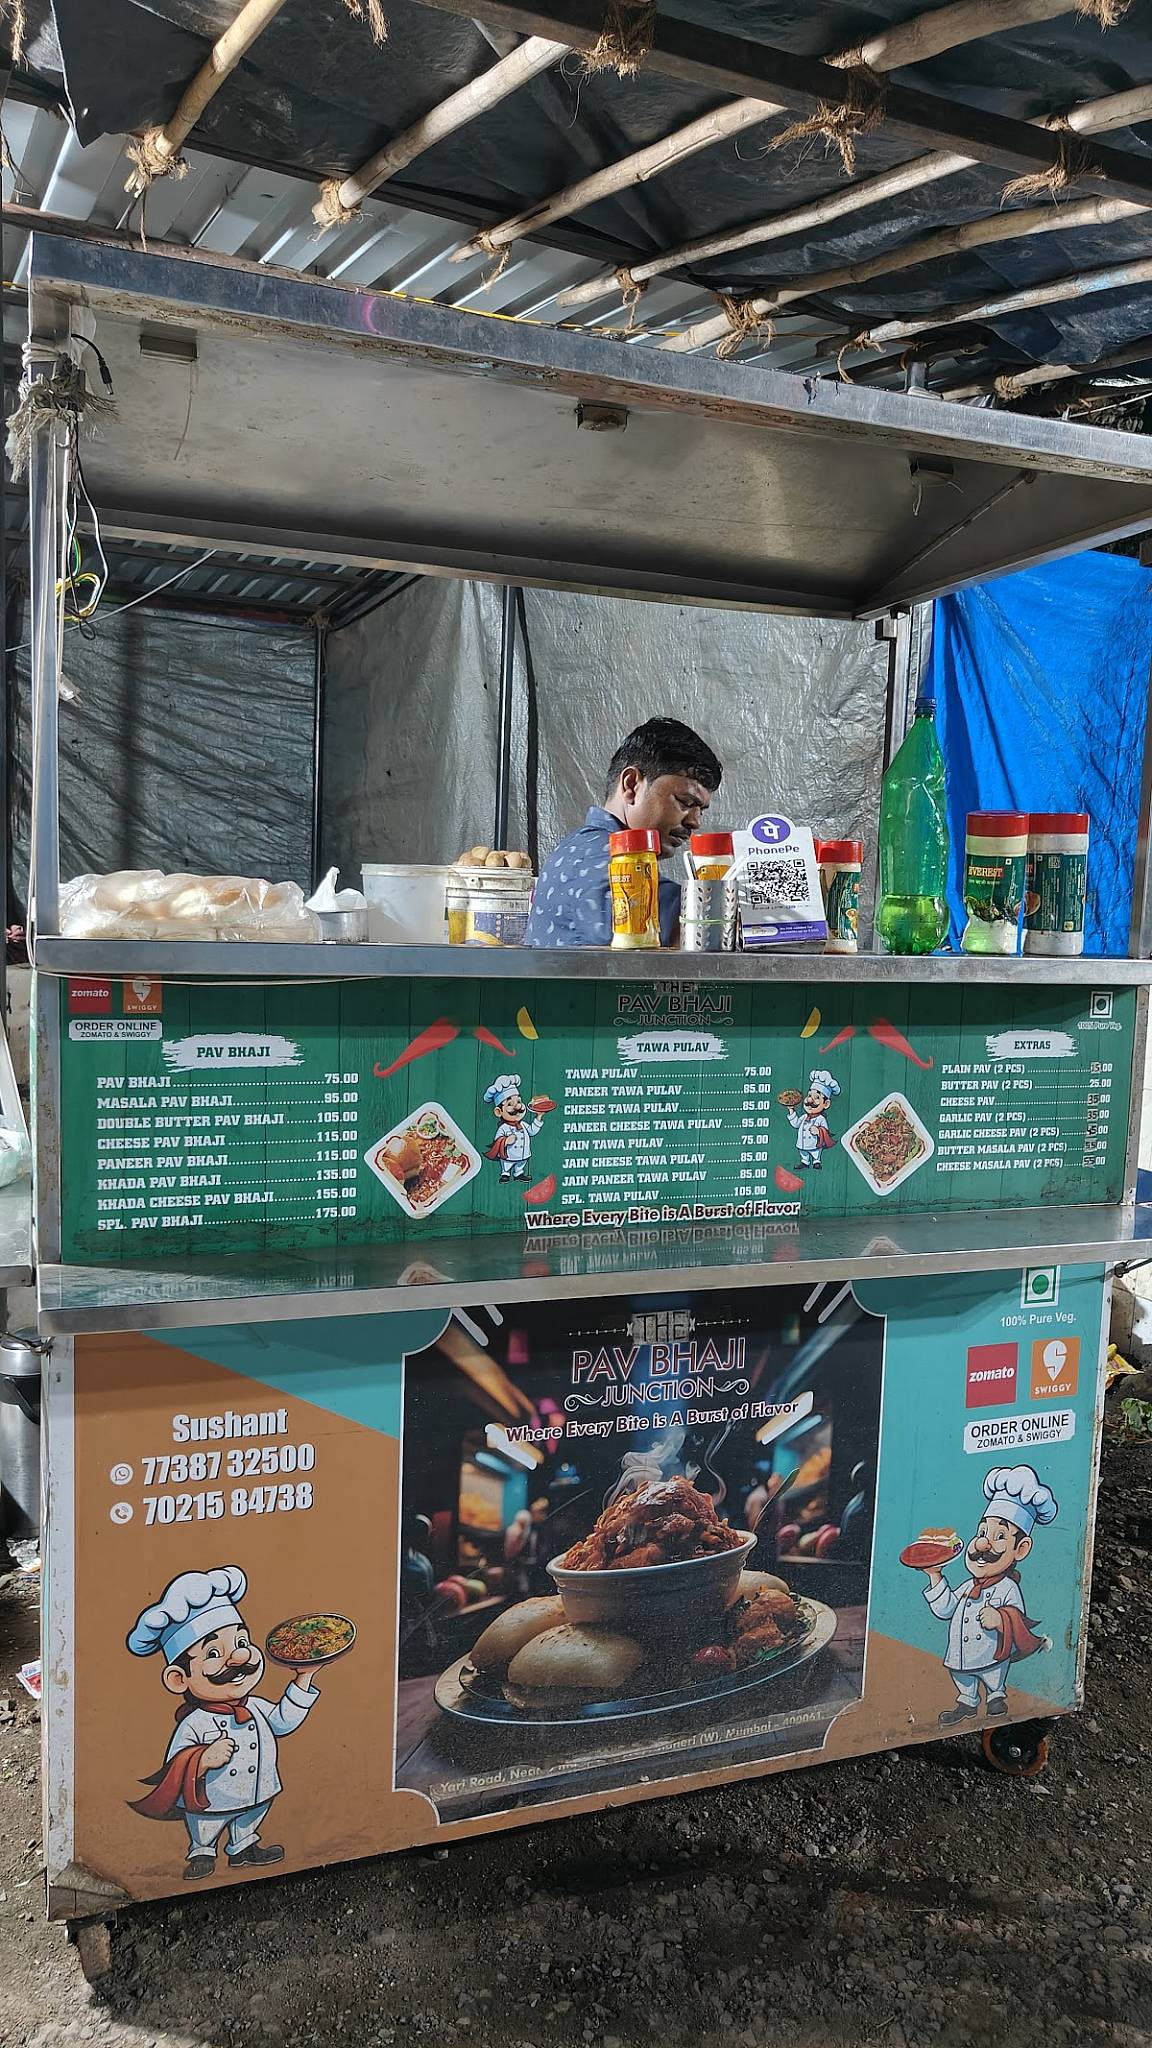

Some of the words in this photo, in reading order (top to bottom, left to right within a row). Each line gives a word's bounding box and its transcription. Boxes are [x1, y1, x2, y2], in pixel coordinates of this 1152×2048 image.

[748, 845, 799, 855] PhonePe
[969, 866, 1003, 877] EVEREST
[661, 981, 692, 993] THE
[618, 995, 662, 1013] PAV
[669, 995, 732, 1013] BHAJI
[75, 1022, 113, 1030] ORDER
[117, 1022, 156, 1030] ONLINE
[637, 1015, 712, 1025] JUNCTION
[197, 1046, 223, 1058] PAV
[228, 1046, 271, 1058] BHAJI
[637, 1043, 670, 1052] TAWA
[674, 1042, 709, 1052] PULAV
[1014, 1040, 1051, 1049] EXTRAS
[566, 1069, 599, 1079] TAWA
[602, 1068, 638, 1079] PULAV
[744, 1067, 771, 1077] 75.00
[942, 1065, 971, 1074] PLAIN
[974, 1064, 991, 1073] PAV
[994, 1064, 1004, 1074] (2
[1006, 1064, 1025, 1074] PCS)
[97, 1077, 124, 1089] PAV
[128, 1077, 171, 1088] BHAJI
[325, 1073, 358, 1084] 75.00
[941, 1080, 977, 1090] BUTTER
[981, 1080, 998, 1089] PAV
[1001, 1080, 1011, 1090] (2
[1014, 1080, 1032, 1090] PCS)
[1089, 1079, 1111, 1088] 25.00
[564, 1087, 608, 1097] PANEER
[611, 1086, 644, 1096] TAWA
[647, 1085, 682, 1095] PULAV
[743, 1084, 770, 1094] 85.00
[97, 1097, 157, 1108] MASALA
[161, 1096, 188, 1108] PAV
[191, 1096, 232, 1107] BHAJI
[324, 1093, 358, 1103] 95.00
[564, 1104, 605, 1115] CHEESE
[608, 1103, 640, 1114] TAWA
[644, 1102, 679, 1113] PULAV
[742, 1101, 769, 1111] 85.00
[940, 1097, 974, 1106] CHEESE
[977, 1096, 995, 1106] PAV
[97, 1118, 151, 1129] DOUBLE
[155, 1115, 211, 1127] BUTTER
[215, 1115, 240, 1127] PAV
[244, 1114, 284, 1125] BHAJI
[317, 1111, 358, 1123] 105.00
[939, 1113, 970, 1122] GARLIC
[973, 1112, 992, 1122] PAV
[995, 1112, 1005, 1122] (2
[1007, 1112, 1026, 1122] PCS)
[563, 1122, 607, 1133] PANEER
[610, 1121, 650, 1132] CHEESE
[653, 1120, 685, 1131] TAWA
[688, 1119, 722, 1129] PULAV
[741, 1118, 769, 1128] 95.00
[939, 1129, 968, 1139] GARLIC
[971, 1128, 1007, 1138] CHEESE
[1009, 1128, 1027, 1137] PAV
[1029, 1127, 1039, 1138] (2
[1041, 1127, 1059, 1137] PCS)
[98, 1138, 150, 1150] CHEESE
[153, 1137, 180, 1149] PAV
[184, 1136, 225, 1147] BHAJI
[317, 1131, 357, 1142] 115.00
[563, 1140, 590, 1151] JAIN
[593, 1139, 625, 1149] TAWA
[627, 1138, 663, 1148] PULAV
[741, 1135, 768, 1146] 75.00
[98, 1158, 153, 1170] PANEER
[156, 1157, 183, 1168] PAV
[187, 1155, 228, 1167] BHAJI
[316, 1150, 357, 1161] 115.00
[563, 1158, 589, 1169] JAIN
[592, 1156, 632, 1167] CHEESE
[635, 1156, 667, 1166] TAWA
[670, 1154, 705, 1165] PULAV
[740, 1152, 768, 1163] 85.00
[98, 1178, 146, 1190] KHADA
[150, 1177, 176, 1189] PAV
[180, 1175, 221, 1187] BHAJI
[316, 1169, 357, 1180] 135.00
[562, 1176, 589, 1187] JAIN
[591, 1174, 634, 1185] PANEER
[636, 1173, 669, 1184] TAWA
[671, 1171, 707, 1182] PULAV
[739, 1169, 767, 1180] 85.00
[98, 1199, 146, 1210] KHADA
[149, 1196, 201, 1208] CHEESE
[205, 1194, 230, 1206] PAV
[234, 1192, 274, 1203] BHAJI
[316, 1187, 356, 1199] 155.00
[562, 1193, 585, 1204] SPL.
[589, 1192, 621, 1203] TAWA
[624, 1190, 659, 1201] PULAV
[734, 1186, 766, 1197] 105.00
[98, 1218, 127, 1231] SPL.
[131, 1217, 158, 1229] PAV
[161, 1216, 203, 1227] BHAJI
[315, 1207, 356, 1218] 175.00
[527, 1214, 578, 1227] Where
[584, 1211, 625, 1226] Every
[629, 1207, 658, 1220] Bite
[663, 1207, 674, 1219] is
[677, 1206, 690, 1219] A
[695, 1205, 734, 1217] Burst
[736, 1203, 751, 1216] of
[755, 1201, 799, 1214] Flavor
[636, 1312, 687, 1343] THE
[1001, 1315, 1026, 1327] 100%
[1030, 1314, 1052, 1325] Pure
[1056, 1312, 1076, 1324] Veg.
[572, 1346, 640, 1384] PAV
[651, 1337, 746, 1377] BHAJI
[969, 1366, 1015, 1383] zomato
[1035, 1384, 1071, 1394] SWIGGY
[602, 1377, 714, 1407] JUNCTION
[173, 1409, 288, 1443] Sushant
[506, 1426, 562, 1442] Where
[566, 1421, 613, 1441] Every
[618, 1416, 649, 1433] Bite
[653, 1413, 667, 1428] is
[671, 1413, 682, 1426] A
[687, 1407, 728, 1425] Burst
[732, 1405, 748, 1420] of
[751, 1401, 799, 1419] Flavor
[971, 1421, 1017, 1438] ORDER
[1022, 1414, 1069, 1431] ONLINE
[977, 1435, 1015, 1449] ZOMATO
[1026, 1429, 1062, 1442] SWIGGY
[142, 1452, 222, 1485] 77387
[227, 1443, 316, 1478] 32500
[143, 1491, 224, 1525] 70215
[231, 1482, 313, 1517] 84738
[726, 1722, 771, 1738] Mumbai
[441, 1779, 466, 1794] Yari
[469, 1772, 506, 1787] Road,
